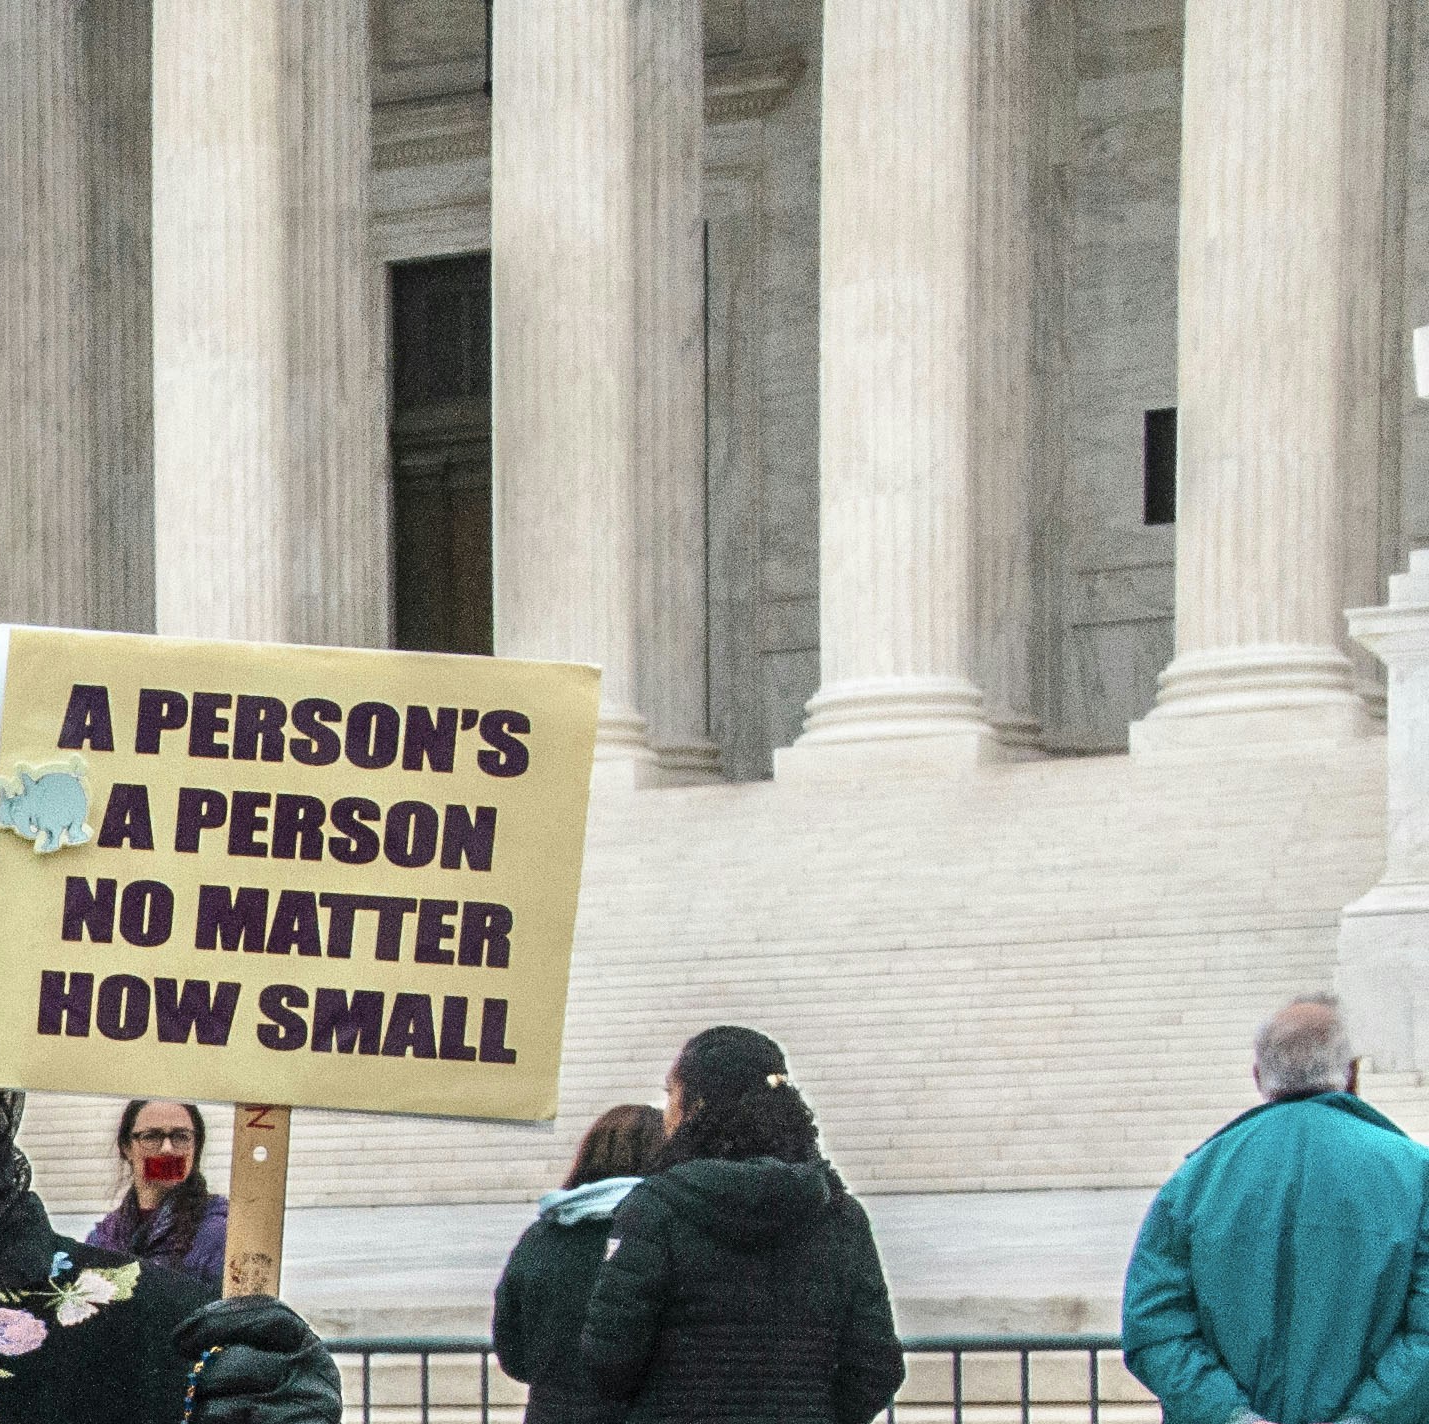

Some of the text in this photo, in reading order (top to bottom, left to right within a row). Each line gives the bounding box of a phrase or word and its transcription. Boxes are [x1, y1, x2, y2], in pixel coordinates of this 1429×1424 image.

[58, 685, 530, 777] A PERSON'S
[98, 784, 496, 871] A PERSON
[62, 877, 512, 968] NO MATTER
[38, 971, 516, 1064] HOW SMALL
